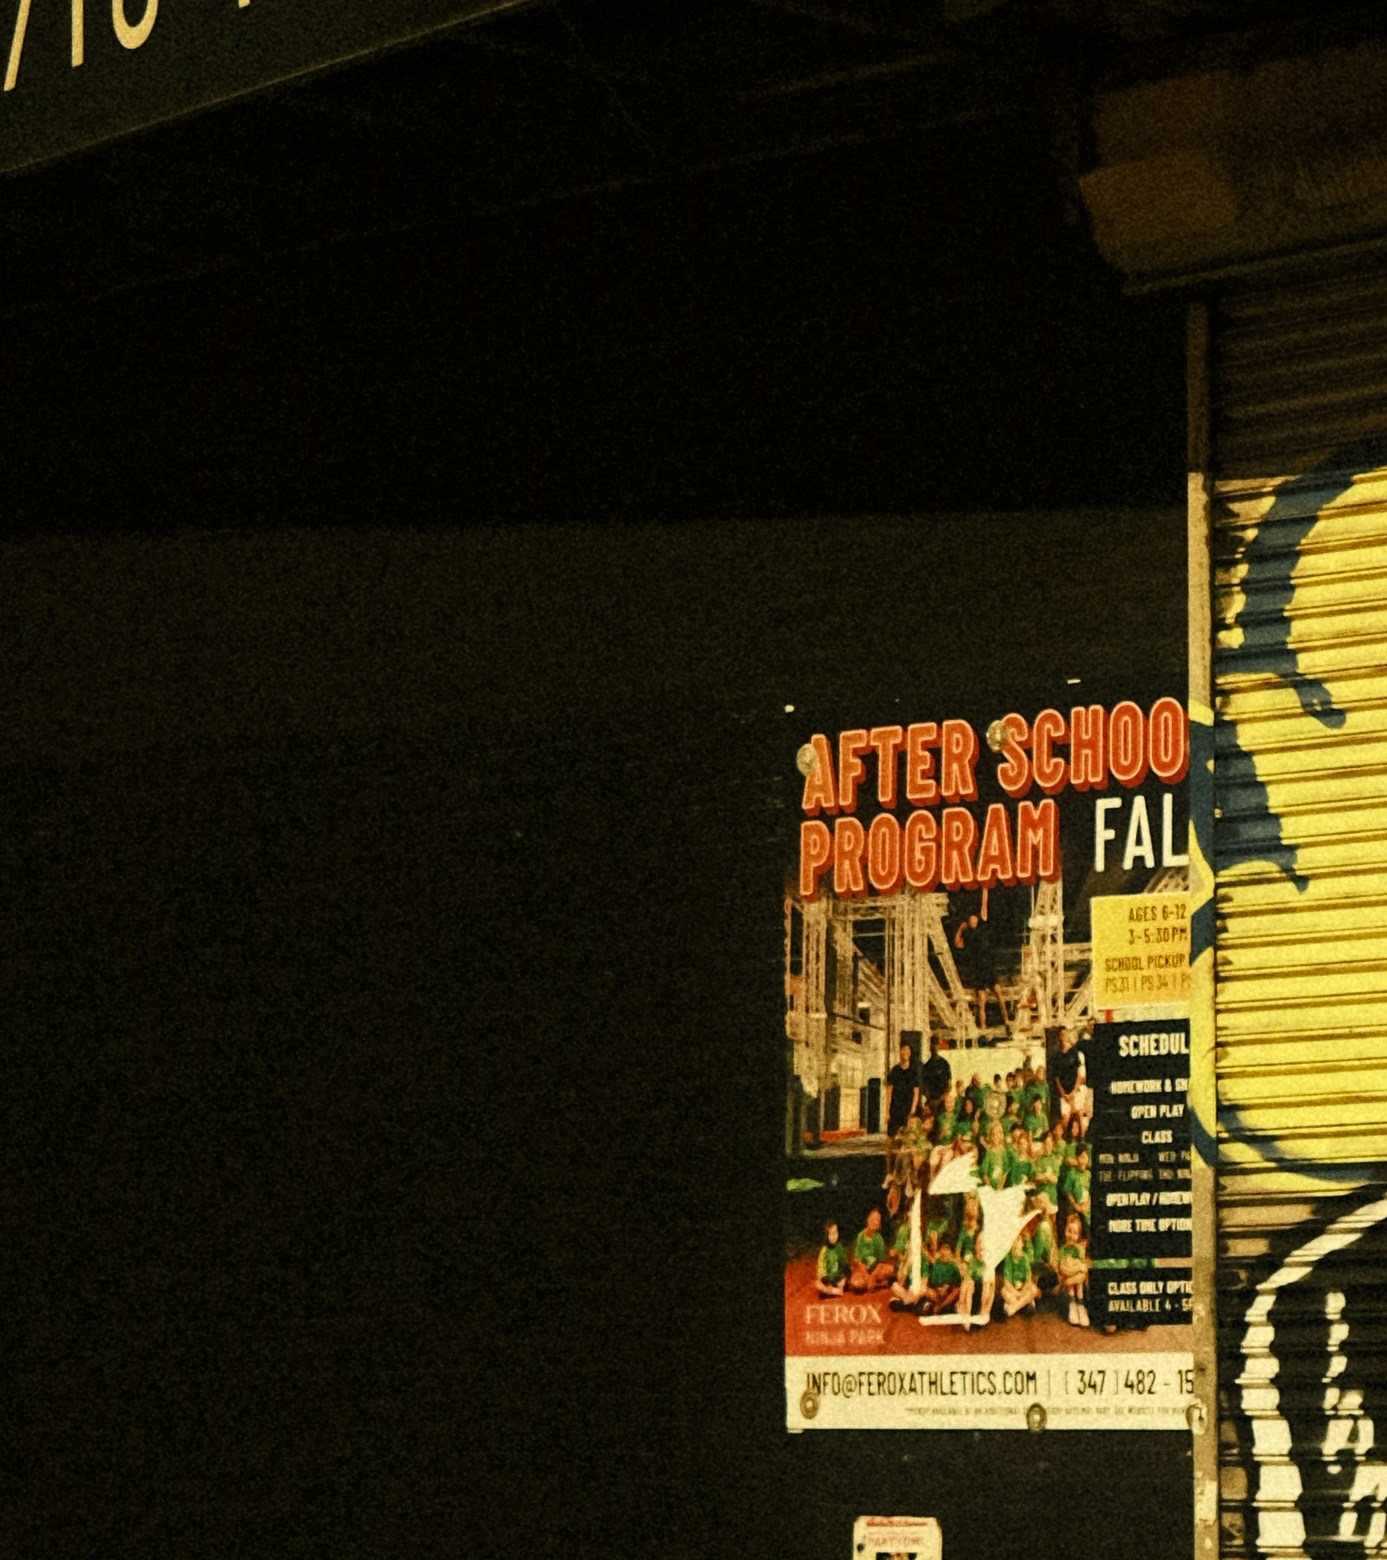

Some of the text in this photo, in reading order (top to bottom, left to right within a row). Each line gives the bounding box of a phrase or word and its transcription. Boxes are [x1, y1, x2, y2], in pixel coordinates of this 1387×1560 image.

[801, 697, 1189, 813] AFTER SCHOO
[800, 792, 1190, 899] PROGRAM FAL
[1128, 904, 1187, 922] AGES 6-12
[1105, 956, 1144, 972] SCHOOL
[1119, 1032, 1189, 1057] SCHEDUL
[1131, 1104, 1184, 1119] OPEN PLAY
[1142, 1130, 1173, 1144] CLASS
[1108, 1282, 1137, 1296] CLASS
[805, 1303, 883, 1326] FEROX
